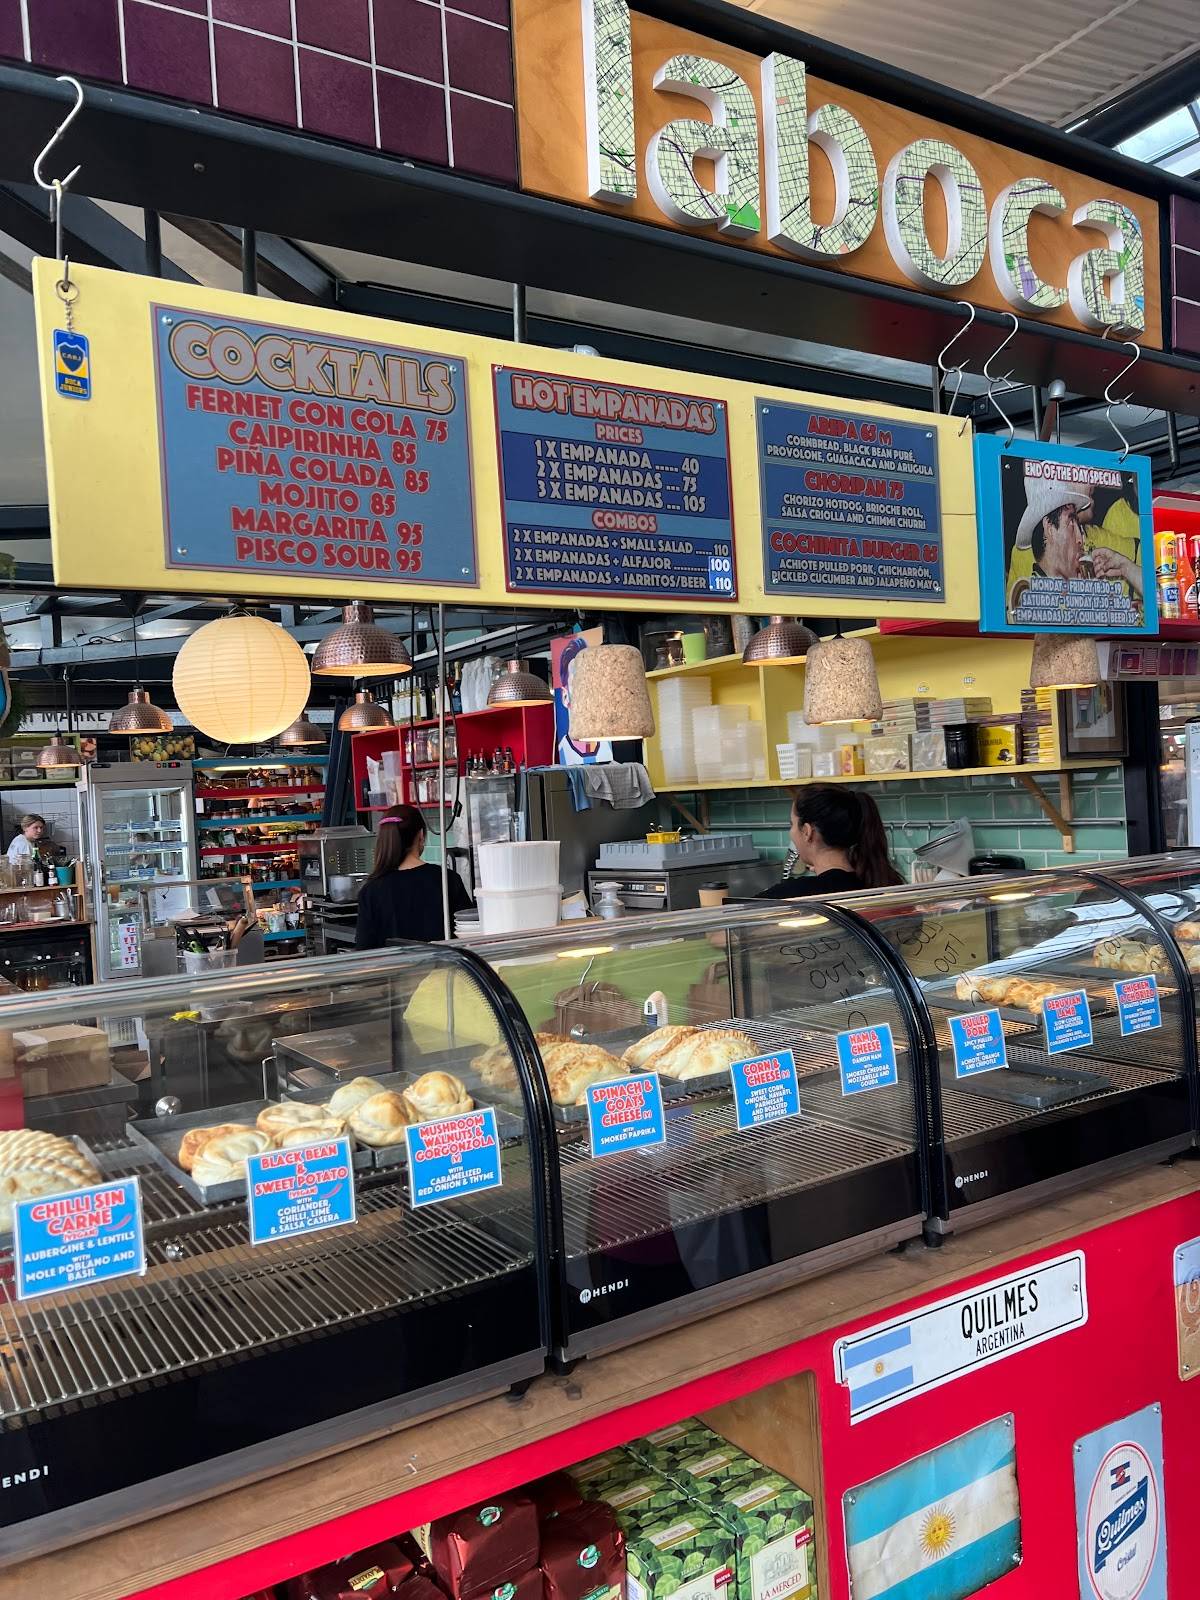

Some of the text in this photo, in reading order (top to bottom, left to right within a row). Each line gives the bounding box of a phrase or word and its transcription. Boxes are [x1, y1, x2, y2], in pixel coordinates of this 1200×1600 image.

[582, 0, 1145, 339] laboca
[168, 321, 456, 414] COCKTAILS
[187, 385, 448, 442] FERNET CON COLA 75
[511, 375, 716, 434] HOT EMPANADAS
[596, 423, 643, 445] PRICES
[807, 416, 876, 442] AREPA 65
[228, 421, 416, 464] CAIPIRINHA 85
[787, 435, 916, 463] CORNBREAD, BLACK BEAN PURÉ,
[216, 445, 430, 492] PIÑA COLADA 85
[546, 441, 700, 474] X EMPANADA 40
[767, 445, 934, 476] PROVOLONE, GUASACACA AND ARUGULA
[537, 460, 697, 493] 2 X EMPANADAS 75
[804, 471, 888, 499] CHORIPAN
[1024, 462, 1122, 487] END OF THE DAY SPECIAL
[259, 482, 397, 517] MOJITO 85
[538, 480, 705, 512] 3 X EMPANADAS 105
[784, 494, 924, 519] CHORIZO HOTDOG, BRIOCHE ROLL,
[231, 507, 423, 546] MARGARITA 95
[592, 511, 657, 532] COMBOS
[782, 506, 926, 530] SALSA CRIOLLA AND CHIMMI CHURRI
[236, 536, 423, 573] PISCO SOUR 95
[534, 531, 729, 556] EMPANADAS SMALL SALAD 110
[770, 530, 861, 558] COCHINITA
[863, 539, 922, 563] BURGER
[534, 549, 730, 572] EMPANADAS ALFAJOR 100
[780, 558, 817, 572] ACHIOTE
[819, 562, 849, 574] PULLED
[851, 563, 876, 575] PORK,
[536, 568, 707, 589] EMPANADAS JARRITOS/BEER
[772, 570, 940, 590] PICKLED CUCUMBER AND JALAPEÑO MAYO
[1031, 579, 1062, 592] MONDAY
[1070, 580, 1094, 593] FRIDAY
[1022, 593, 1060, 607] SATURDAY
[1065, 595, 1093, 608] SUNDAY
[1015, 609, 1127, 623] EMPANADAS QUILMES BEER
[41, 711, 113, 723] MARKE
[780, 936, 840, 965] SOLD
[1122, 981, 1149, 994] CHICKEN
[1047, 995, 1081, 1010] PERUVIAN
[1057, 1007, 1076, 1019] LAMB
[961, 1014, 989, 1029] PULLED
[966, 1023, 989, 1038] PORK
[849, 1031, 870, 1044] HAM
[851, 1040, 881, 1055] CHEESE
[743, 1061, 771, 1076] CORN
[747, 1070, 781, 1087] CHEESE
[592, 1080, 653, 1102] SPINACH &
[751, 1088, 767, 1097] SWEET
[606, 1094, 645, 1113] GOATS
[752, 1102, 788, 1116] AND ROASTED
[754, 1098, 784, 1108] PARMESAN
[765, 1109, 788, 1120] PEPPERS
[419, 1114, 484, 1138] MUSHROOM
[602, 1110, 641, 1127] CHEESE
[424, 1127, 473, 1149] WALNUTS
[600, 1127, 656, 1145] SMOKED PAPRIKA
[261, 1143, 337, 1170] BLACK BEAN
[415, 1136, 496, 1162] GORGONZOLA
[254, 1167, 349, 1196] SWEET POTATO
[418, 1171, 495, 1196] RED ONION THYME
[430, 1168, 482, 1186] CARAMELIZED
[963, 1169, 989, 1184] HENDI
[31, 1188, 125, 1223] CHILLI SIN
[277, 1200, 331, 1217] CORIANDER,
[310, 1207, 331, 1219] LIME
[48, 1210, 113, 1236] CARNE
[278, 1214, 340, 1233] SALSA CASERA
[24, 1231, 135, 1264] AUBERGINE LENTILS
[73, 1254, 91, 1262] WITH
[26, 1251, 135, 1283] MOLE POBLANO AND
[67, 1269, 97, 1282] BASIL
[592, 1278, 629, 1298] HENDI
[961, 1279, 1039, 1340] QUILMES
[976, 1322, 1026, 1357] ARGENTINA
[1098, 1497, 1145, 1554] Quilmes
[772, 1572, 801, 1597] MERCED
